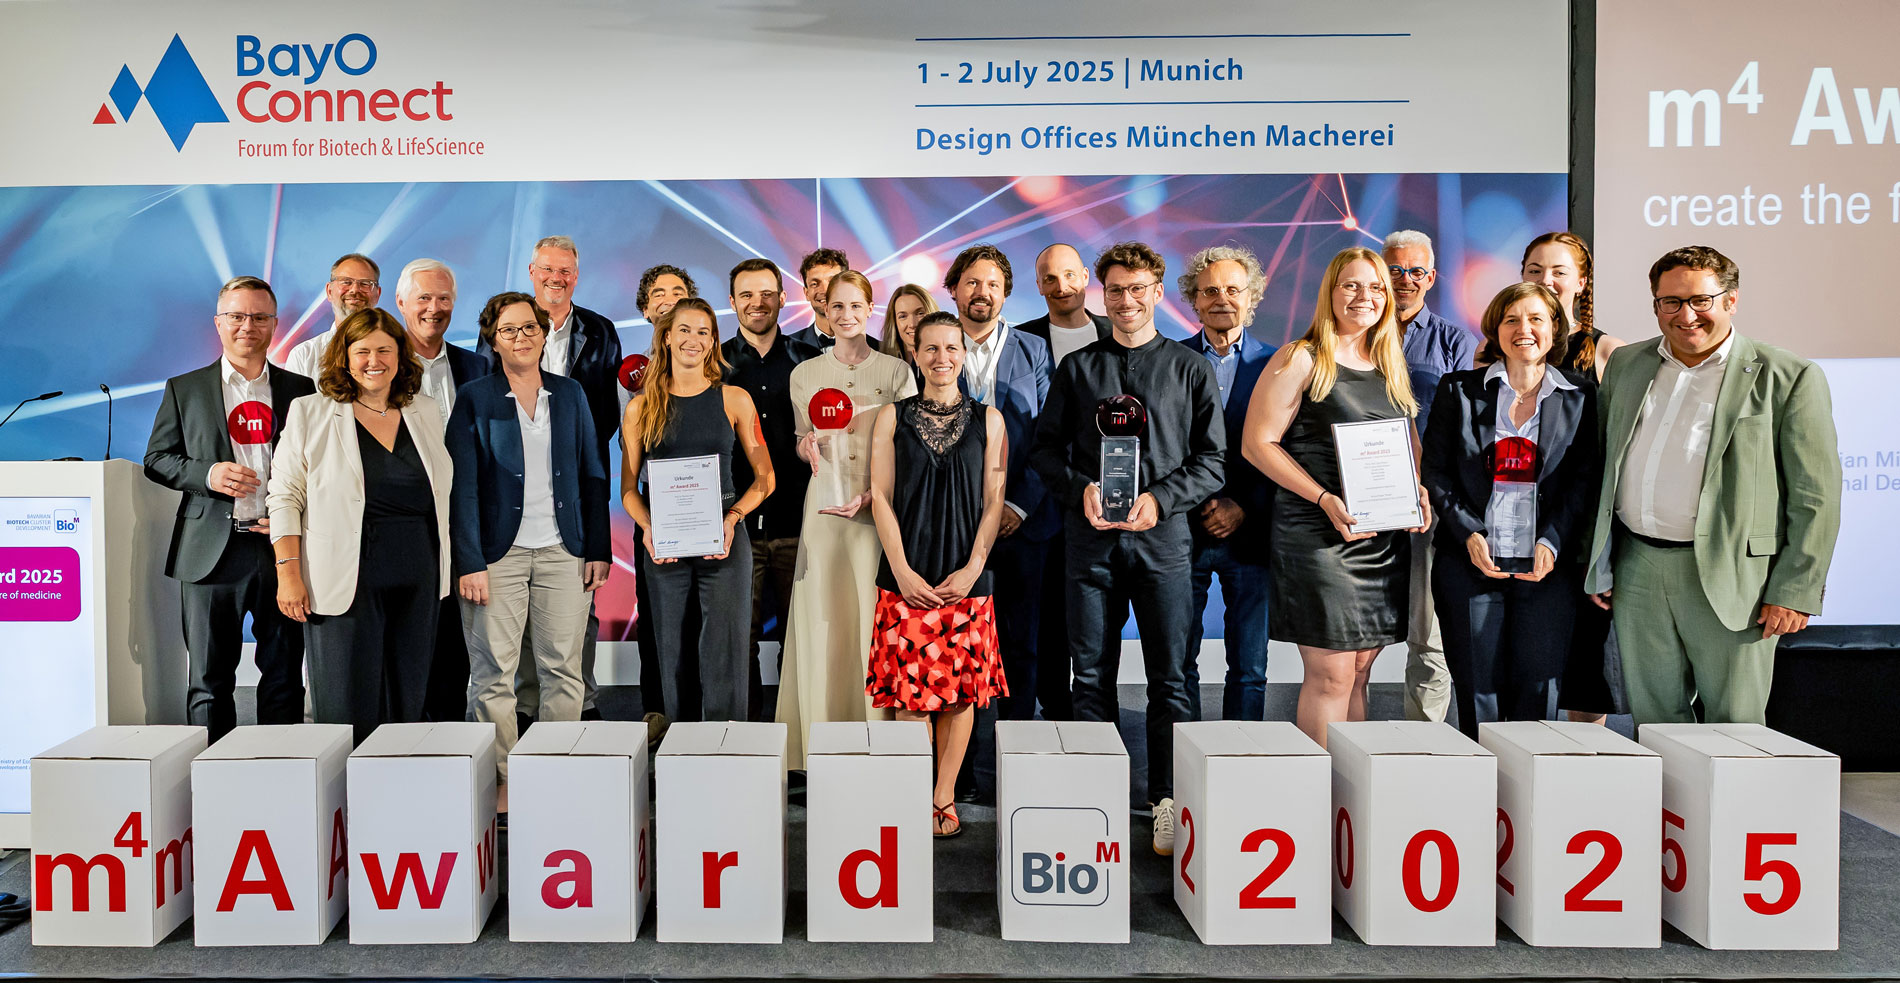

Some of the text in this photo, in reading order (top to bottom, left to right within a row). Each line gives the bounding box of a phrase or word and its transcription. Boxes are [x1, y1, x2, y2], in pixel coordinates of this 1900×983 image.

[236, 33, 377, 84] BayO
[917, 62, 928, 84] 1
[958, 62, 973, 84] 2
[982, 60, 1038, 88] July
[1047, 61, 1114, 83] 2025
[1140, 58, 1243, 82] Munich
[236, 81, 453, 123] Connect
[238, 136, 485, 157] Forum for Biotech & LifeScience
[916, 123, 1394, 156] Design Offices München Macherei
[1644, 185, 1782, 227] create
[1800, 183, 1871, 225] the
[20, 569, 63, 584] 2025
[9, 590, 19, 600] of
[20, 590, 62, 600] medicine
